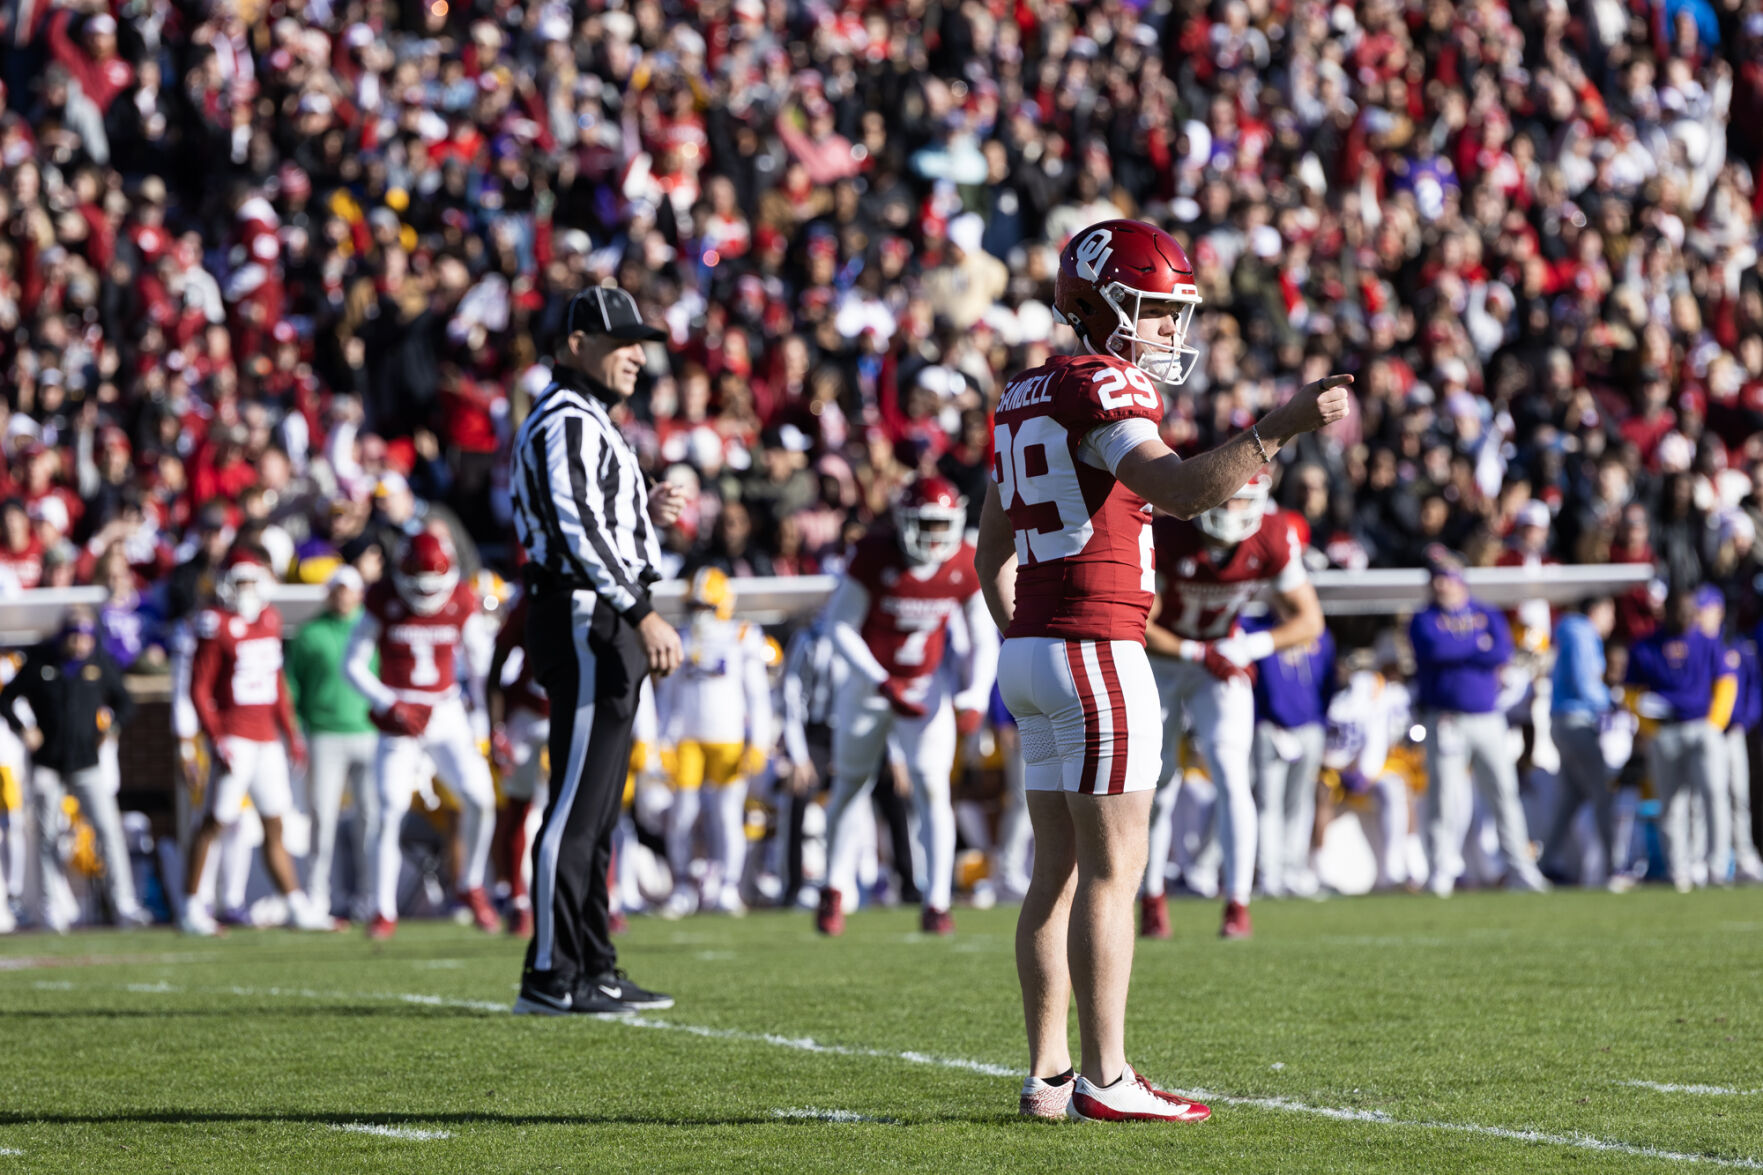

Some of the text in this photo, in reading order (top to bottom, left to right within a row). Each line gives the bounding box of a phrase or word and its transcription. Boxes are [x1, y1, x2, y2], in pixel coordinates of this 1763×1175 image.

[995, 370, 1056, 414] SANDELL
[1092, 366, 1159, 411] 29
[894, 612, 942, 666] 7
[409, 640, 440, 687] 1
